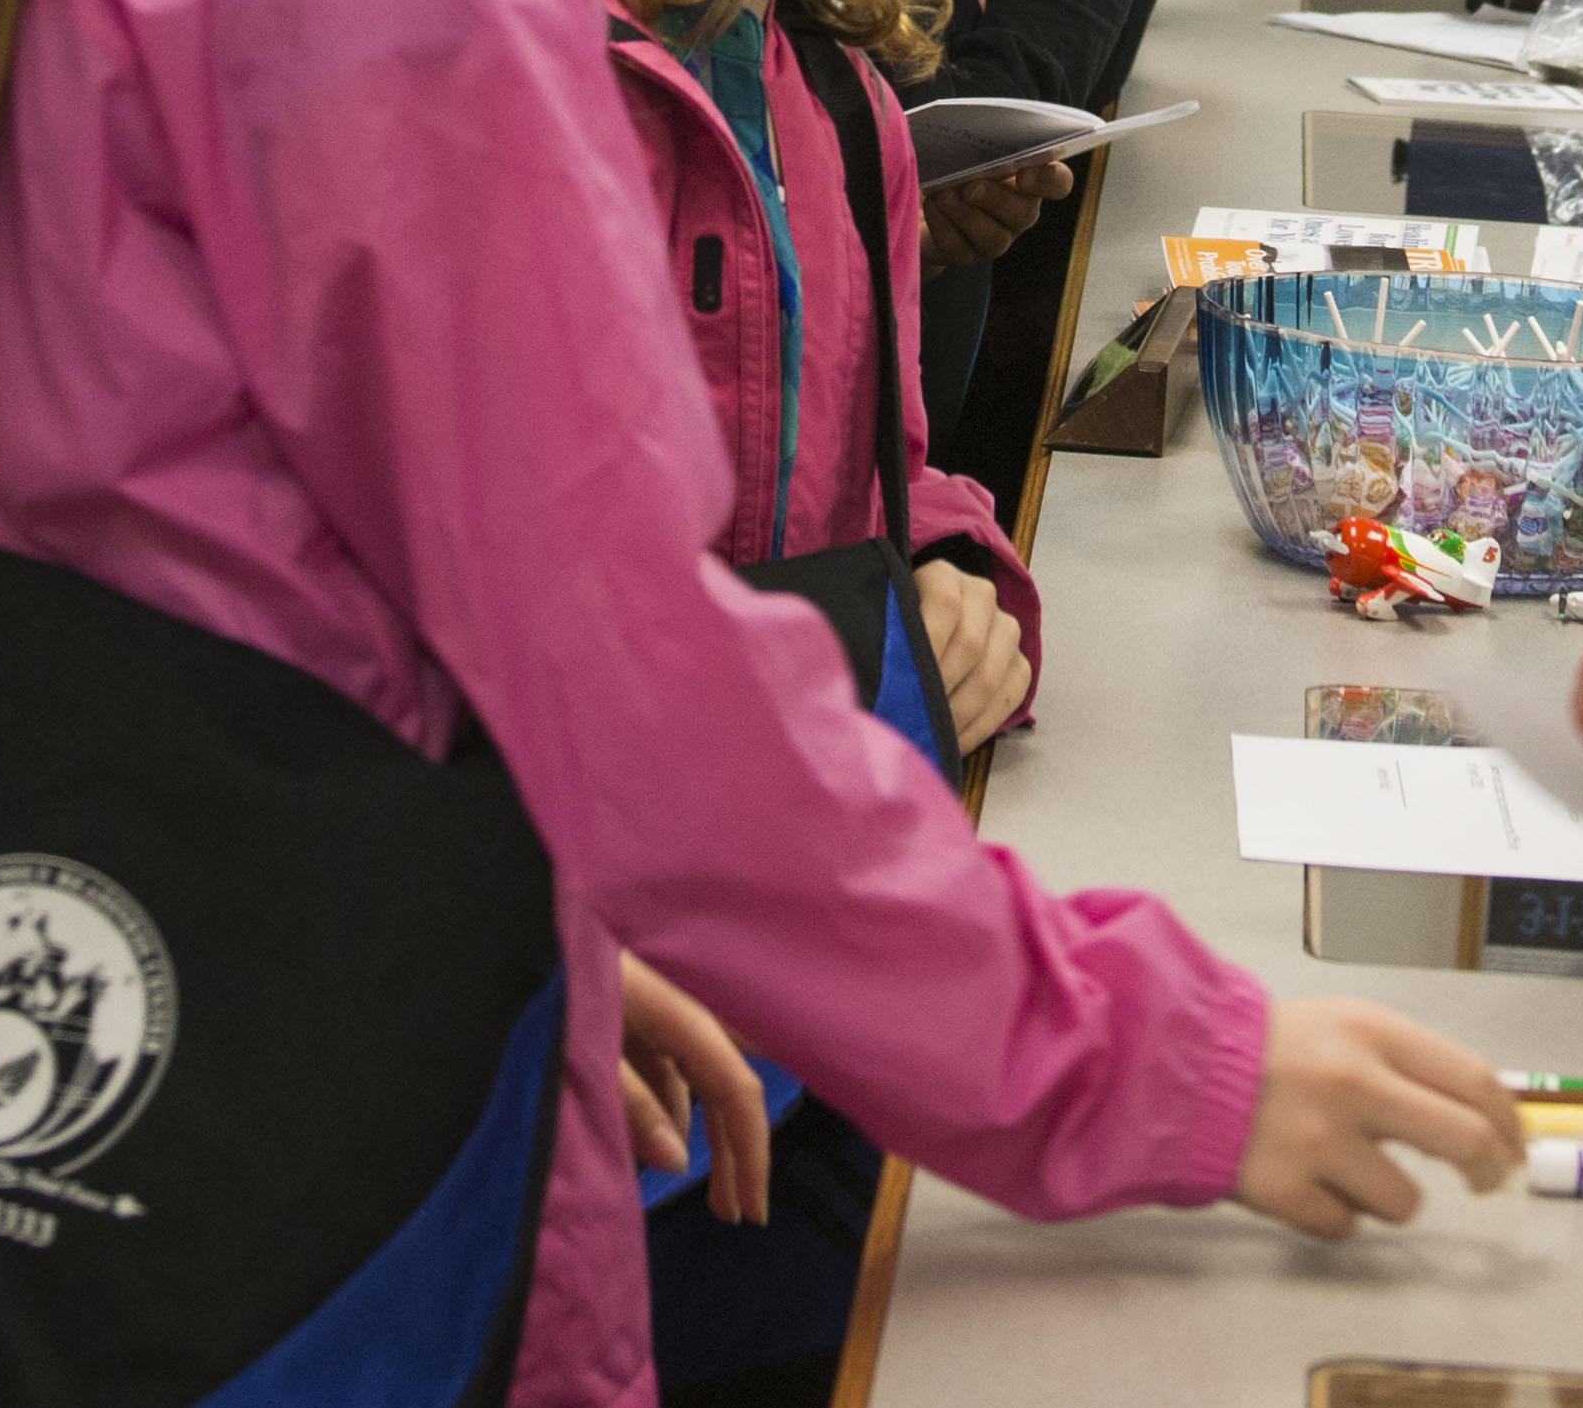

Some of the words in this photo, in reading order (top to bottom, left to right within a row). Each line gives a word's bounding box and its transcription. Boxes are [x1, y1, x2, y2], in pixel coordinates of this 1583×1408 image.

[1334, 224, 1364, 245] Love
[1402, 224, 1433, 248] Healin
[1482, 545, 1500, 564] 5
